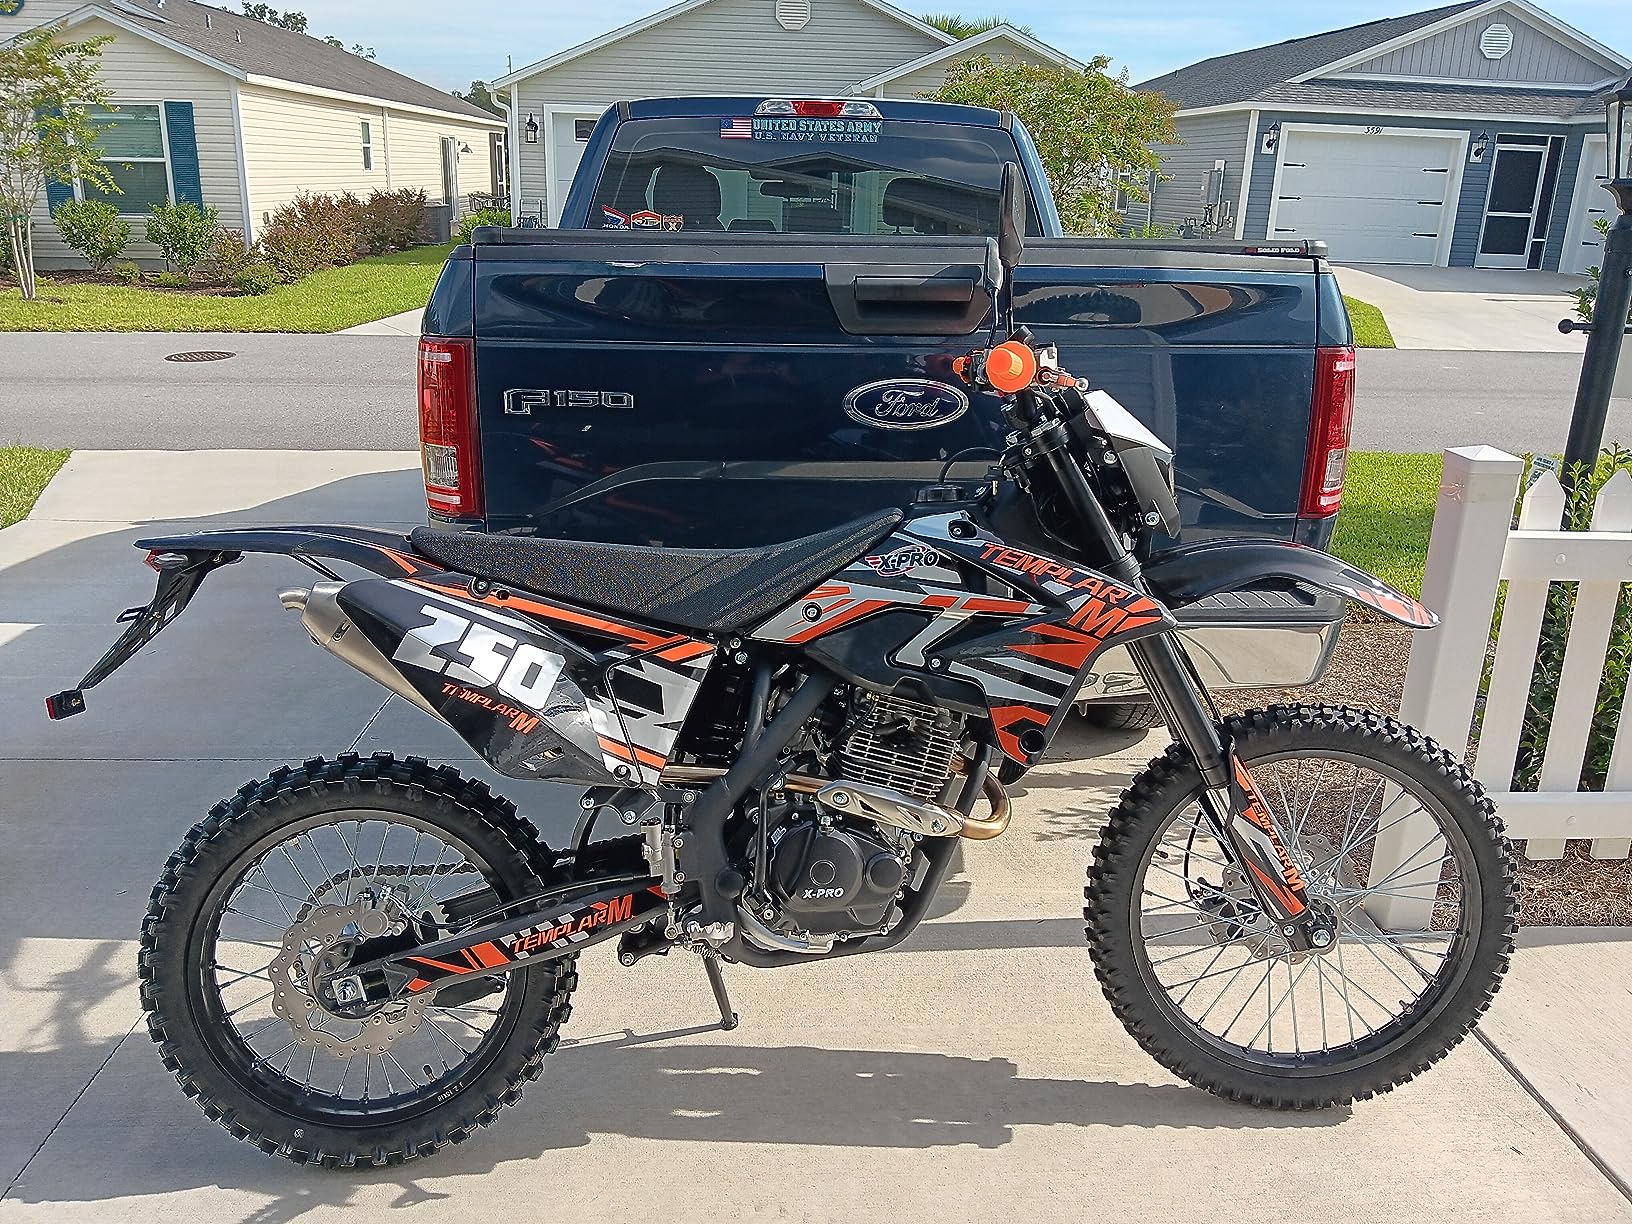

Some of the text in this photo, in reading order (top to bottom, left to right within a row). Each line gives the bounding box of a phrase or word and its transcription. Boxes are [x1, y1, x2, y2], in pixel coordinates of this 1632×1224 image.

[752, 119, 882, 133] UNITED STATES ARMY
[754, 132, 879, 143] U.S. NAVY VETERAN
[874, 388, 940, 418] Ford
[879, 550, 940, 570] X-PRO
[391, 603, 567, 711] 250
[802, 887, 845, 900] X-PRO
